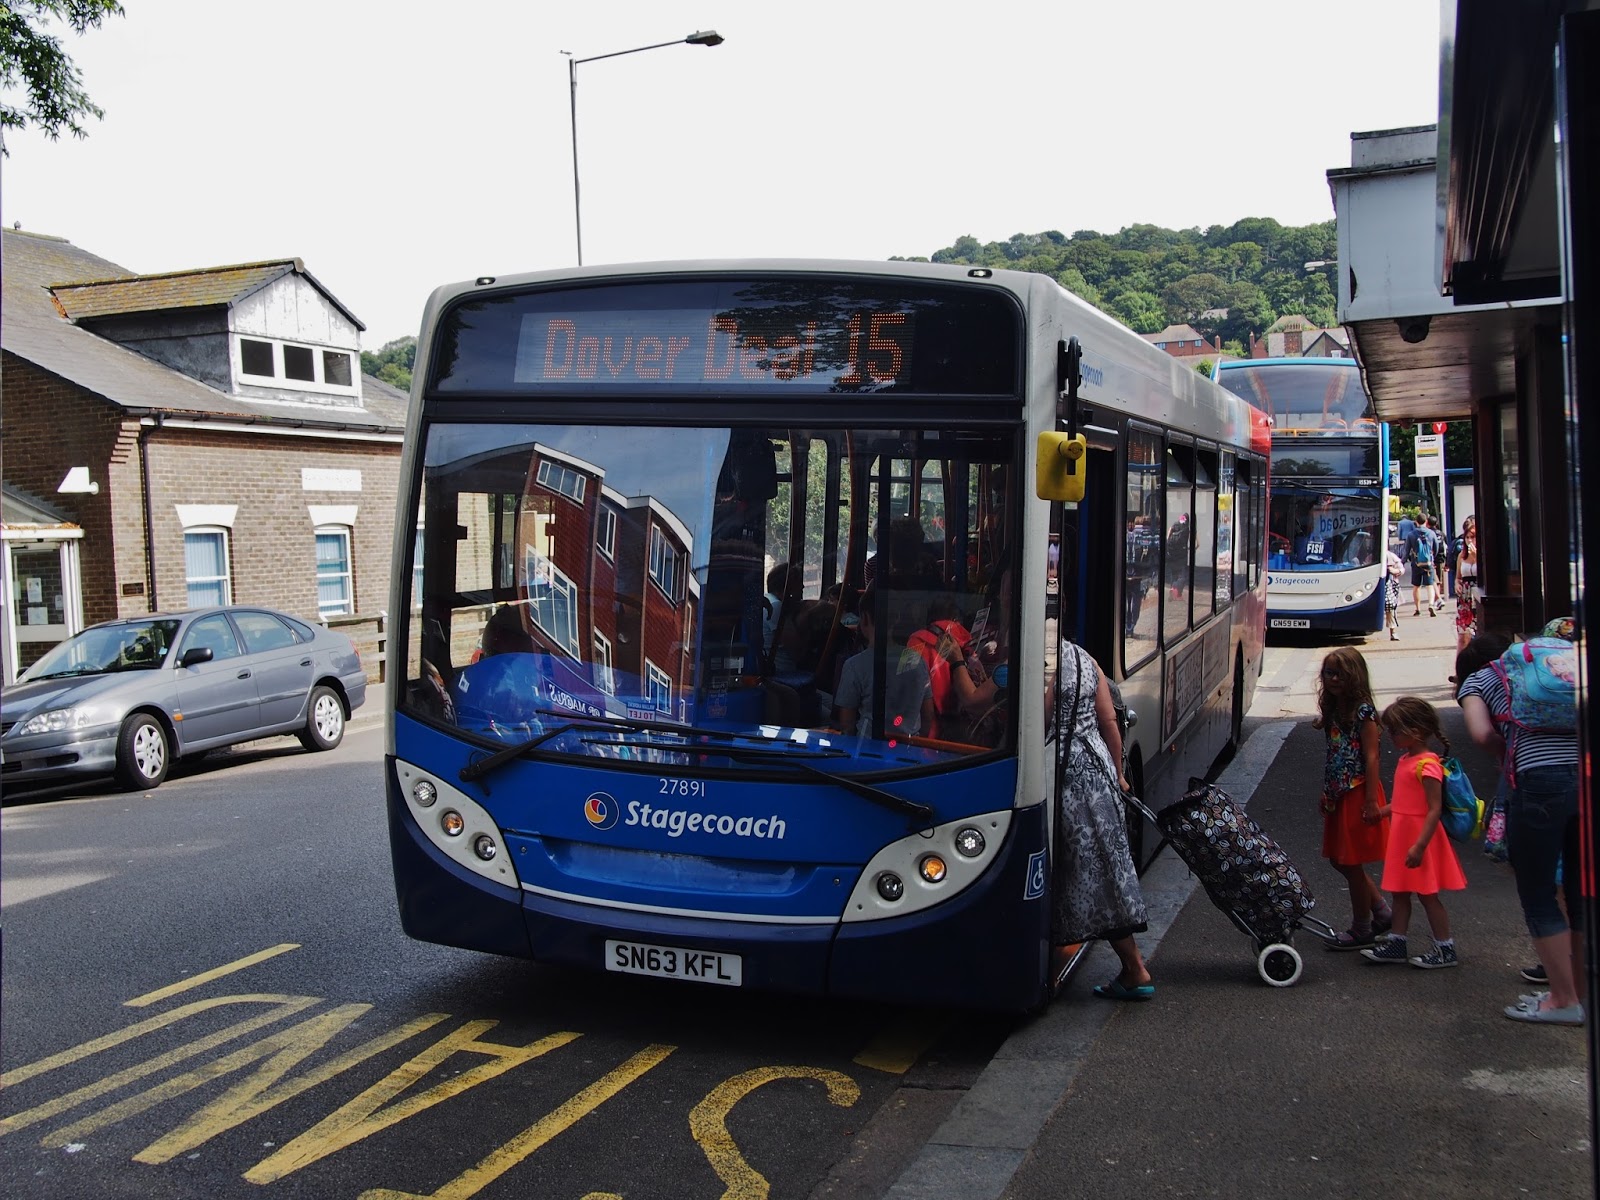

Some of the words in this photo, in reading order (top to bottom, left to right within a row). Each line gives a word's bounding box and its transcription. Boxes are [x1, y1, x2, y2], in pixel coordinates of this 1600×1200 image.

[543, 319, 690, 379] Dover
[703, 316, 817, 381] Deal
[841, 312, 906, 384] 15
[1080, 362, 1105, 389] agecoach
[1306, 543, 1325, 554] FISH
[1274, 577, 1320, 586] Stagecoach
[1273, 619, 1292, 627] GN59
[658, 778, 706, 797] 27891
[625, 800, 787, 839] Stagecoach
[615, 944, 677, 974] SN63
[684, 952, 732, 981] KFL
